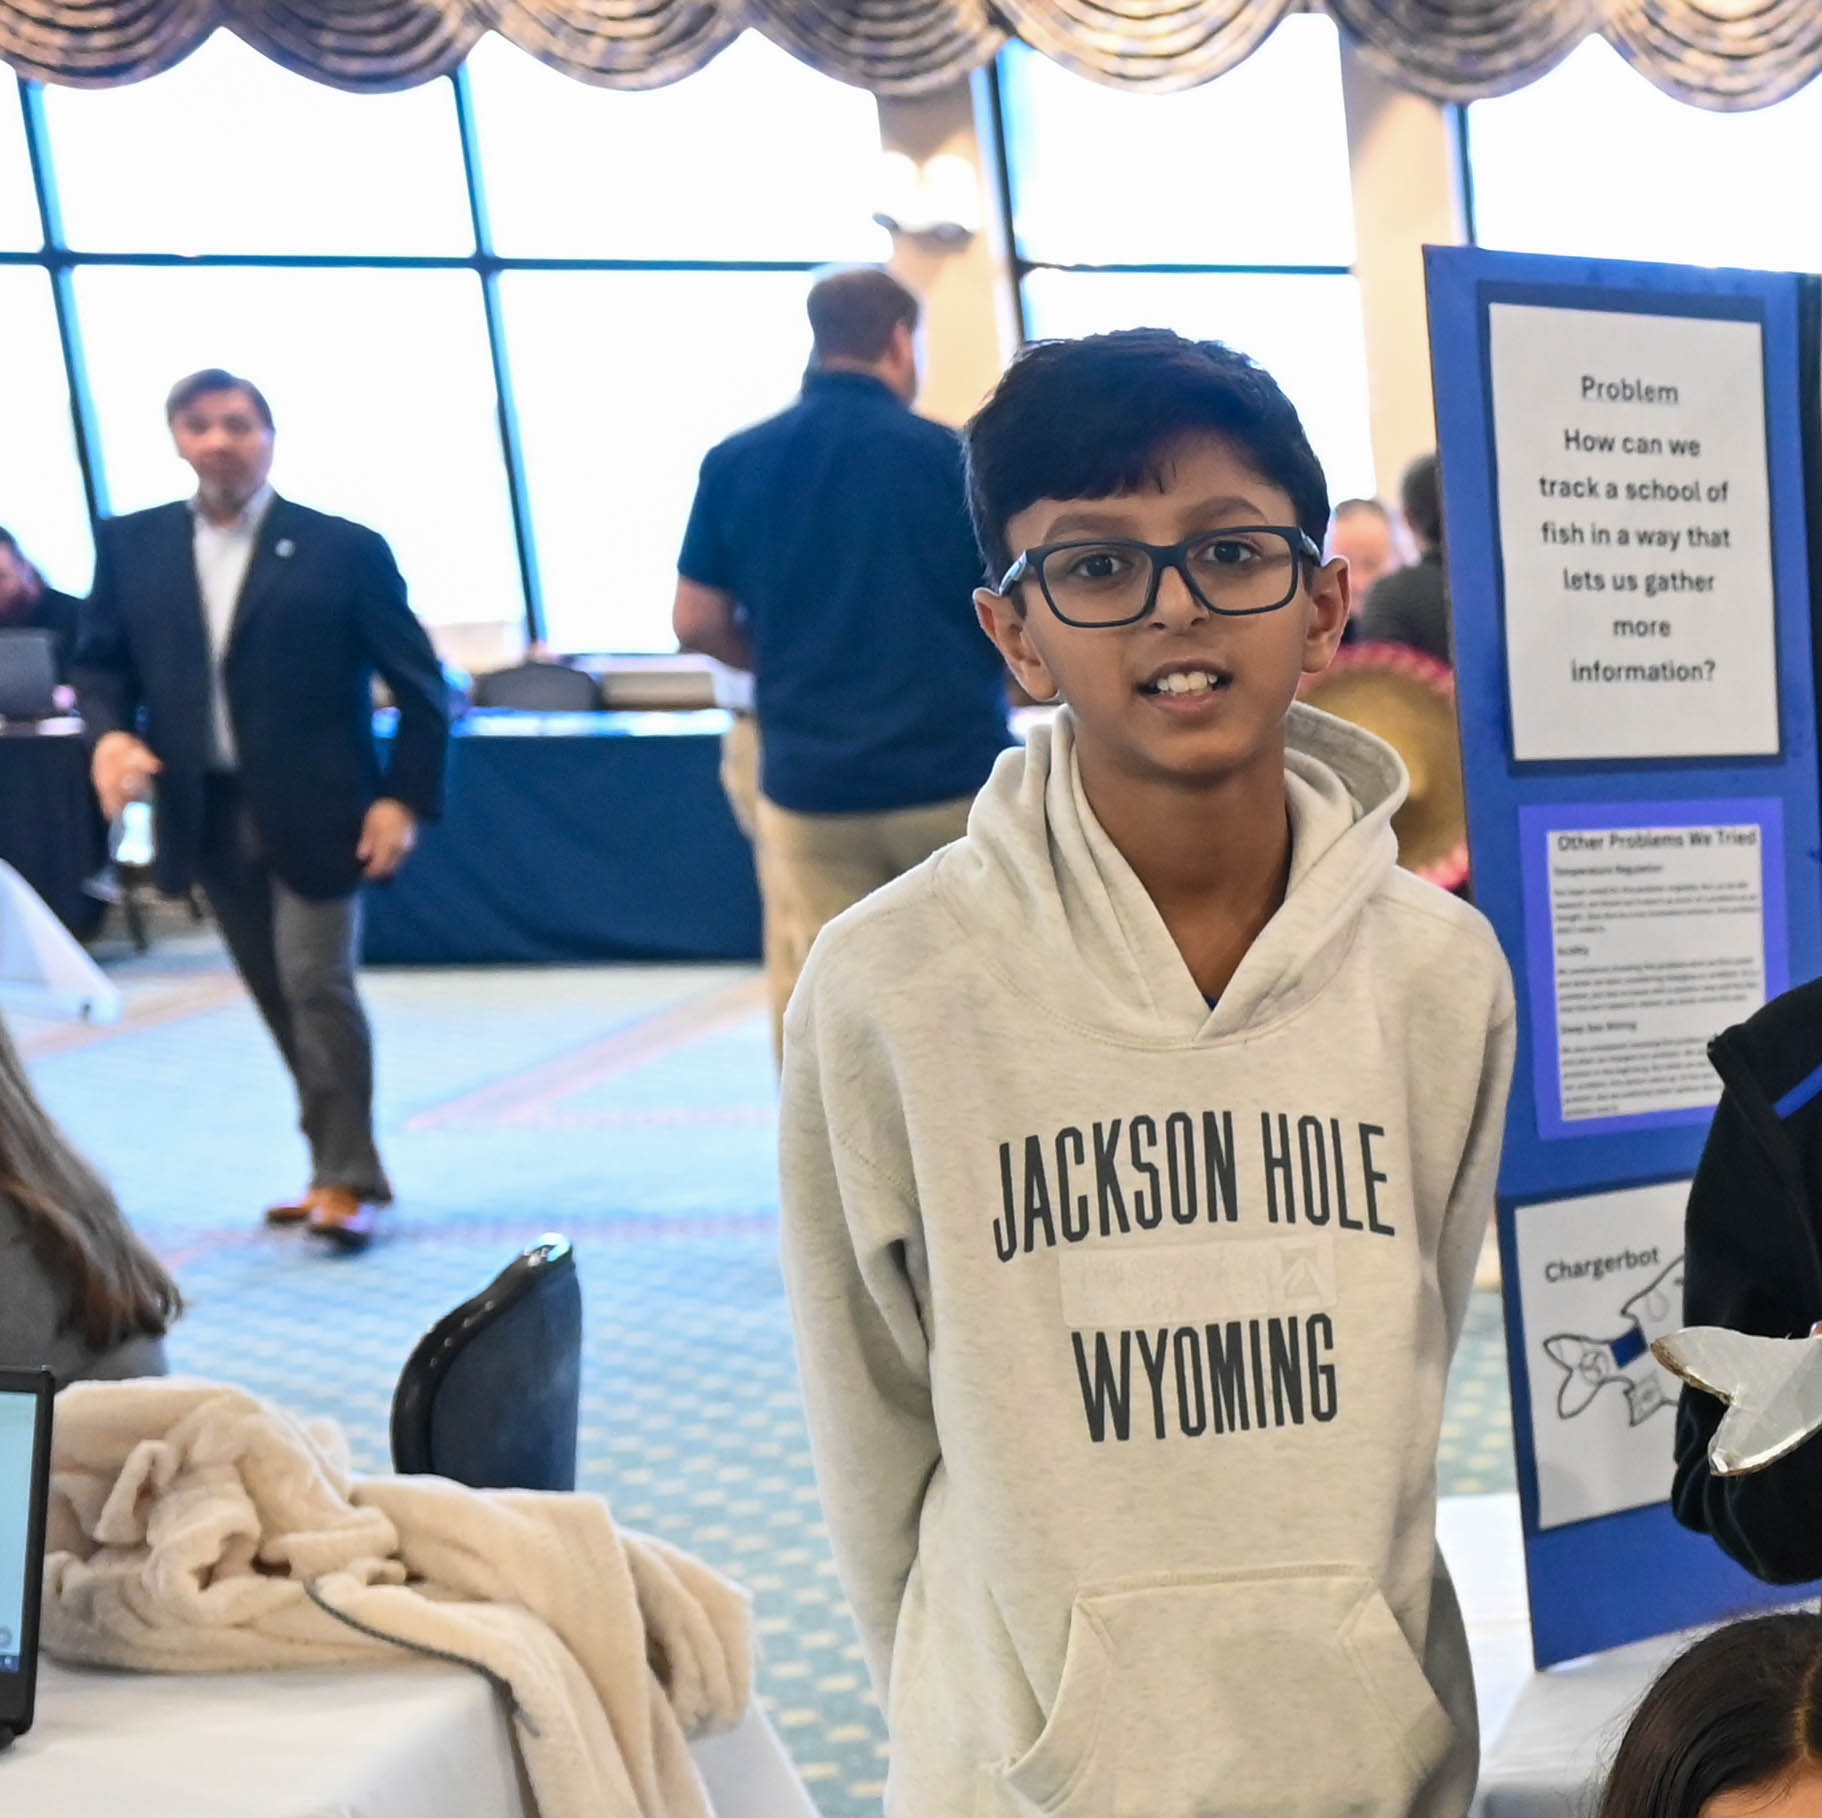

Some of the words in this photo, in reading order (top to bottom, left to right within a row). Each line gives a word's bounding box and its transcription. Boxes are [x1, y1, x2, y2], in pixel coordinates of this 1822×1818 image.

[1581, 375, 1679, 404] Problem
[1563, 428, 1615, 453] How
[1622, 436, 1662, 455] can
[1669, 439, 1701, 456] we
[1539, 477, 1599, 499] track
[1605, 481, 1618, 500] a
[1625, 478, 1702, 501] school
[1706, 480, 1728, 502] of
[1541, 520, 1584, 545] fish
[1591, 523, 1610, 545] in
[1617, 527, 1630, 546] a
[1637, 527, 1680, 550] way
[1687, 526, 1731, 548] that
[1563, 567, 1605, 591] lets
[1612, 572, 1637, 591] us
[1645, 570, 1715, 597] gather
[1612, 618, 1671, 637] more
[1571, 660, 1716, 682] information?
[1557, 835, 1604, 851] Other
[1609, 833, 1685, 849] Problems
[1690, 832, 1712, 846] We
[1718, 830, 1757, 846] Tried
[993, 1111, 1238, 1262] JACKSON
[1261, 1111, 1395, 1237] HOLE
[1545, 1247, 1659, 1283] Chargerbot
[1071, 1312, 1338, 1443] WYOMING
